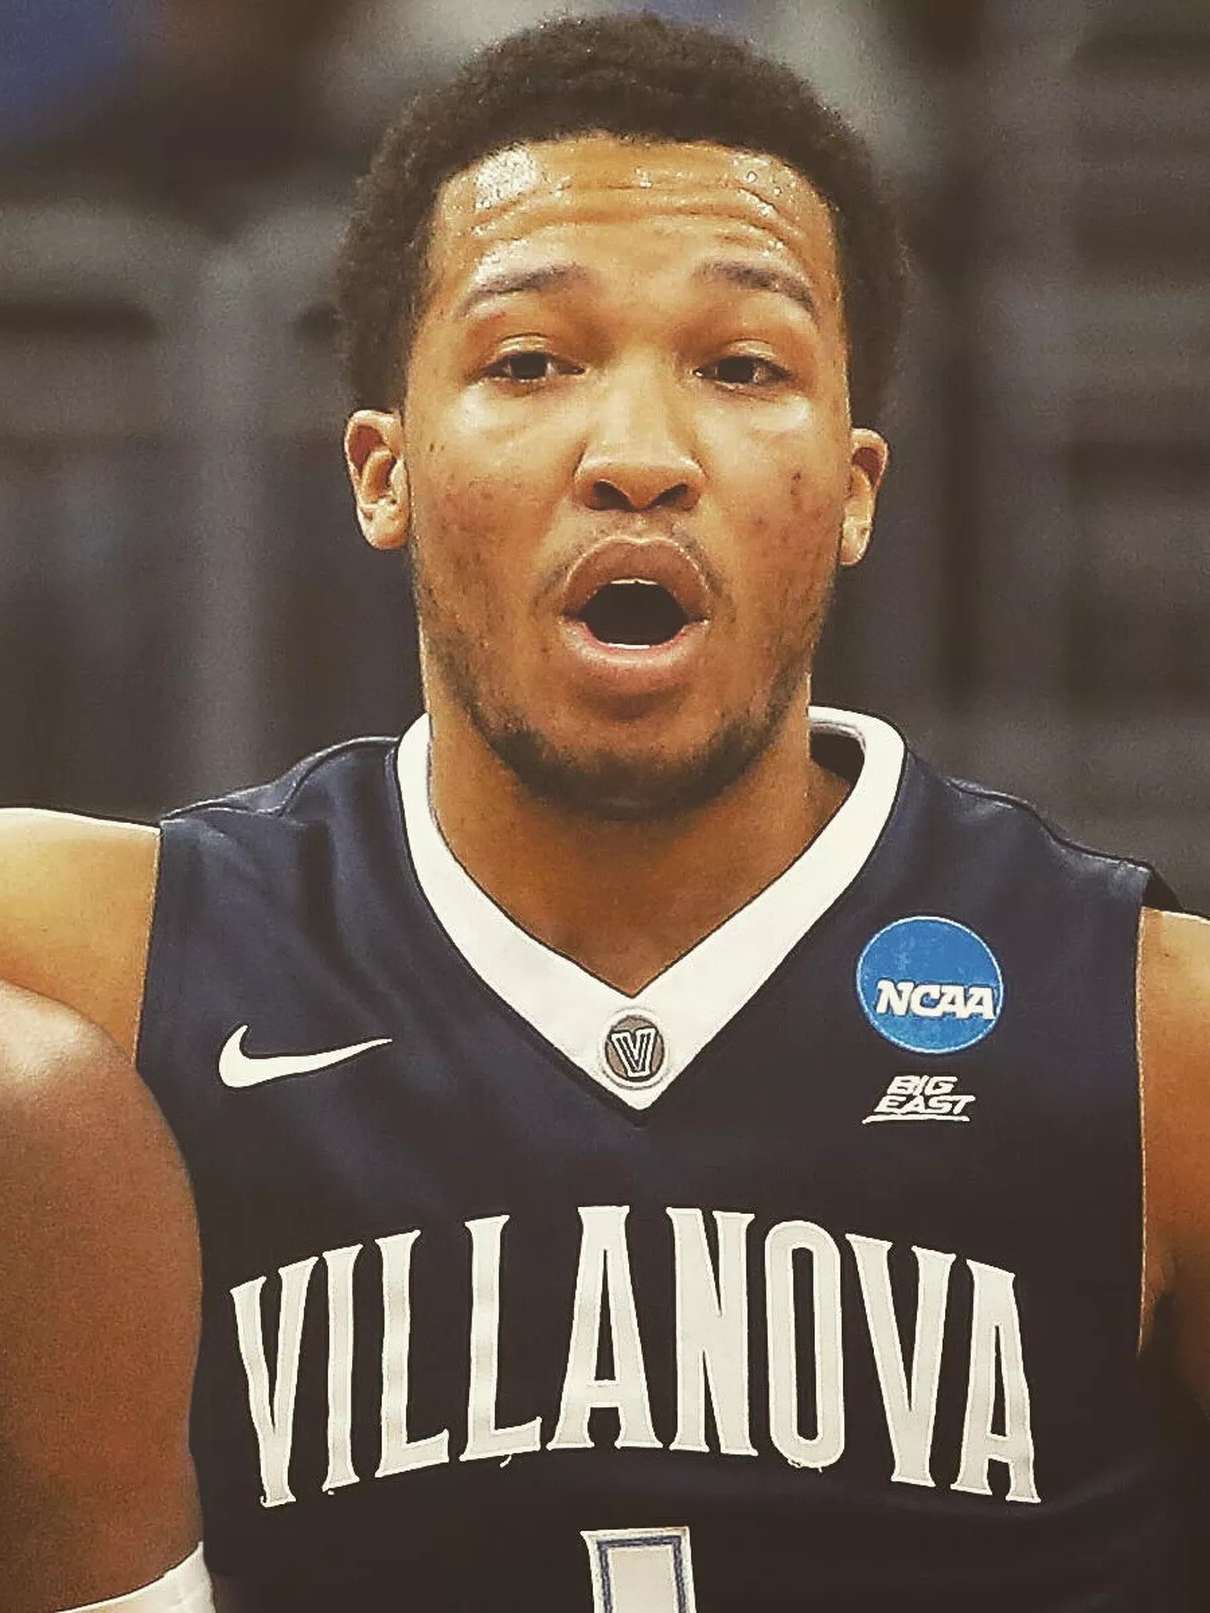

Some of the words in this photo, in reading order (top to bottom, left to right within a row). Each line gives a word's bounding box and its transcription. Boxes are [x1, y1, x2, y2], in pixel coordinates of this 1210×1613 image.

[876, 978, 996, 1019] NCAA
[886, 1074, 958, 1096] BIG
[873, 1094, 976, 1115] EAST
[230, 1205, 1041, 1508] VILLANOVA
